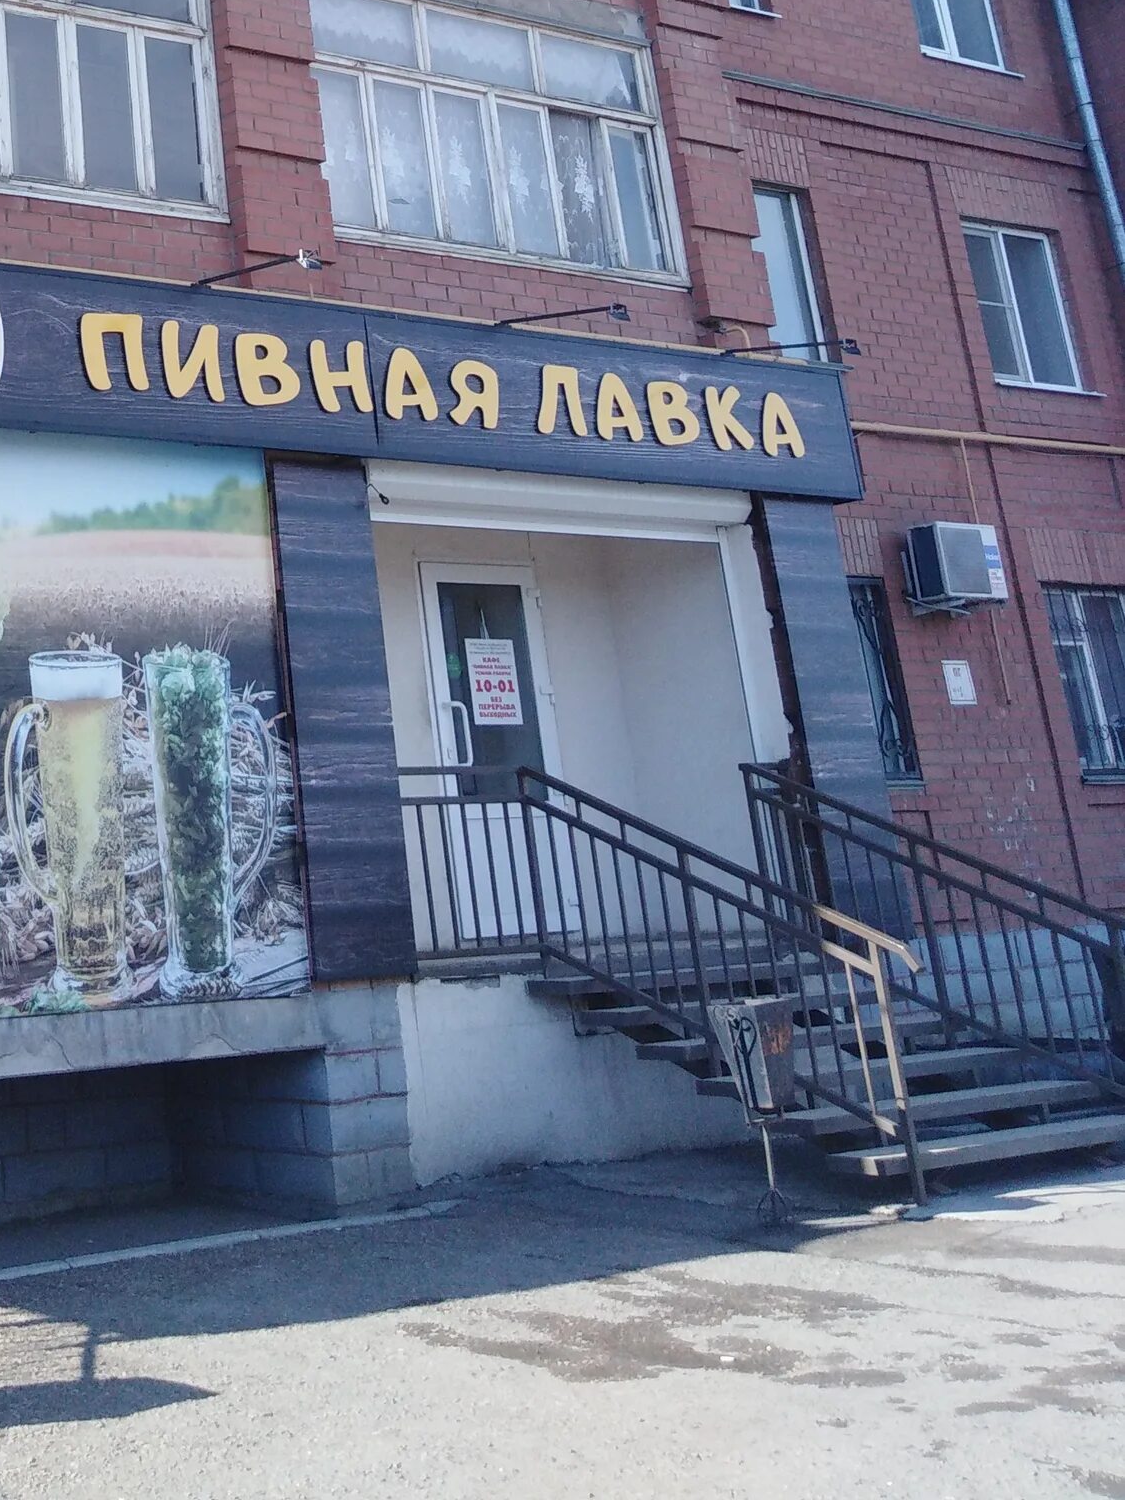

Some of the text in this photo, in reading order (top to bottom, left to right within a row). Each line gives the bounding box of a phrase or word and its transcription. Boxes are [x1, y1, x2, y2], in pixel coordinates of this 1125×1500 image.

[80, 311, 807, 460] ПИВНАЯ ЛАВКА
[475, 679, 516, 693] 10-01
